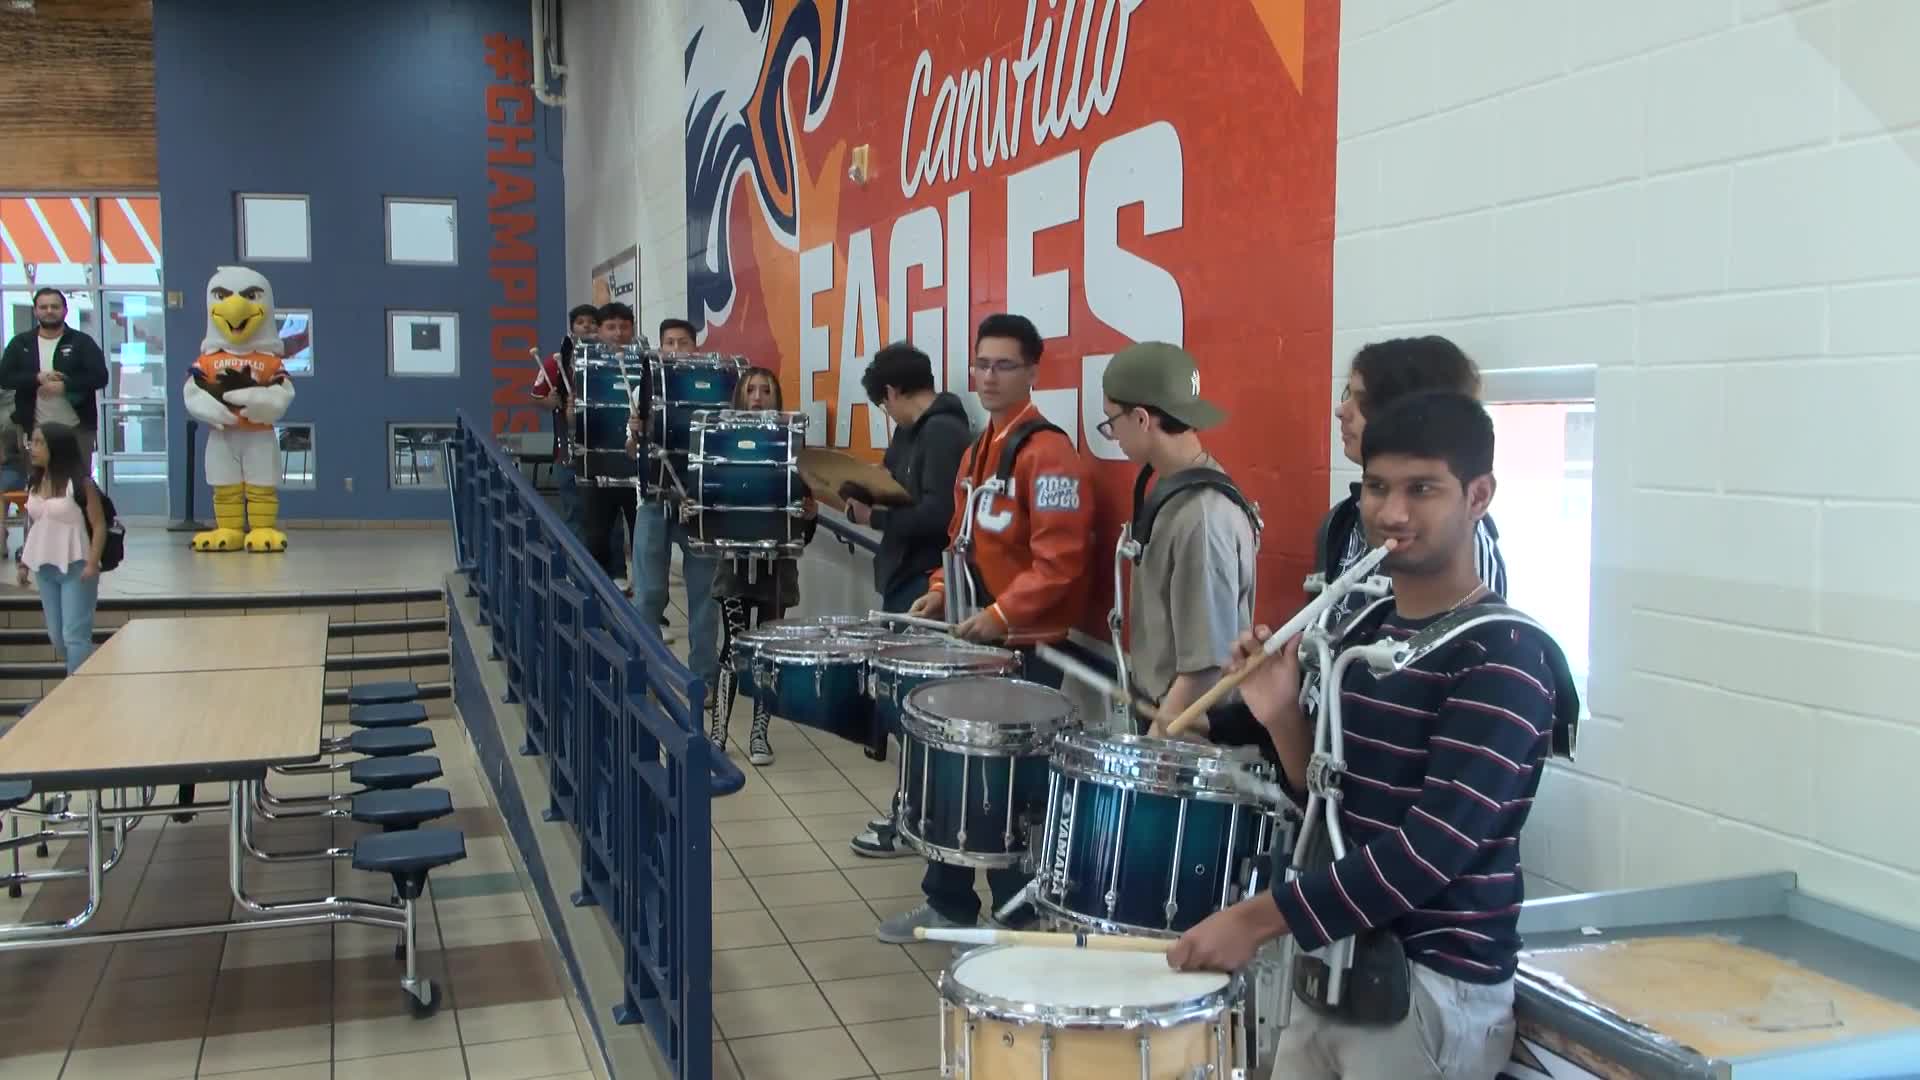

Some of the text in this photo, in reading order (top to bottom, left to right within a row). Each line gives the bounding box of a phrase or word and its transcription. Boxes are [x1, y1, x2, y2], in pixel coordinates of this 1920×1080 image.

[901, 0, 1142, 198] Canutillo
[483, 32, 541, 438] #CHAMPIONS
[799, 120, 1184, 460] EAGLES
[1051, 818, 1070, 895] YAMAHA
